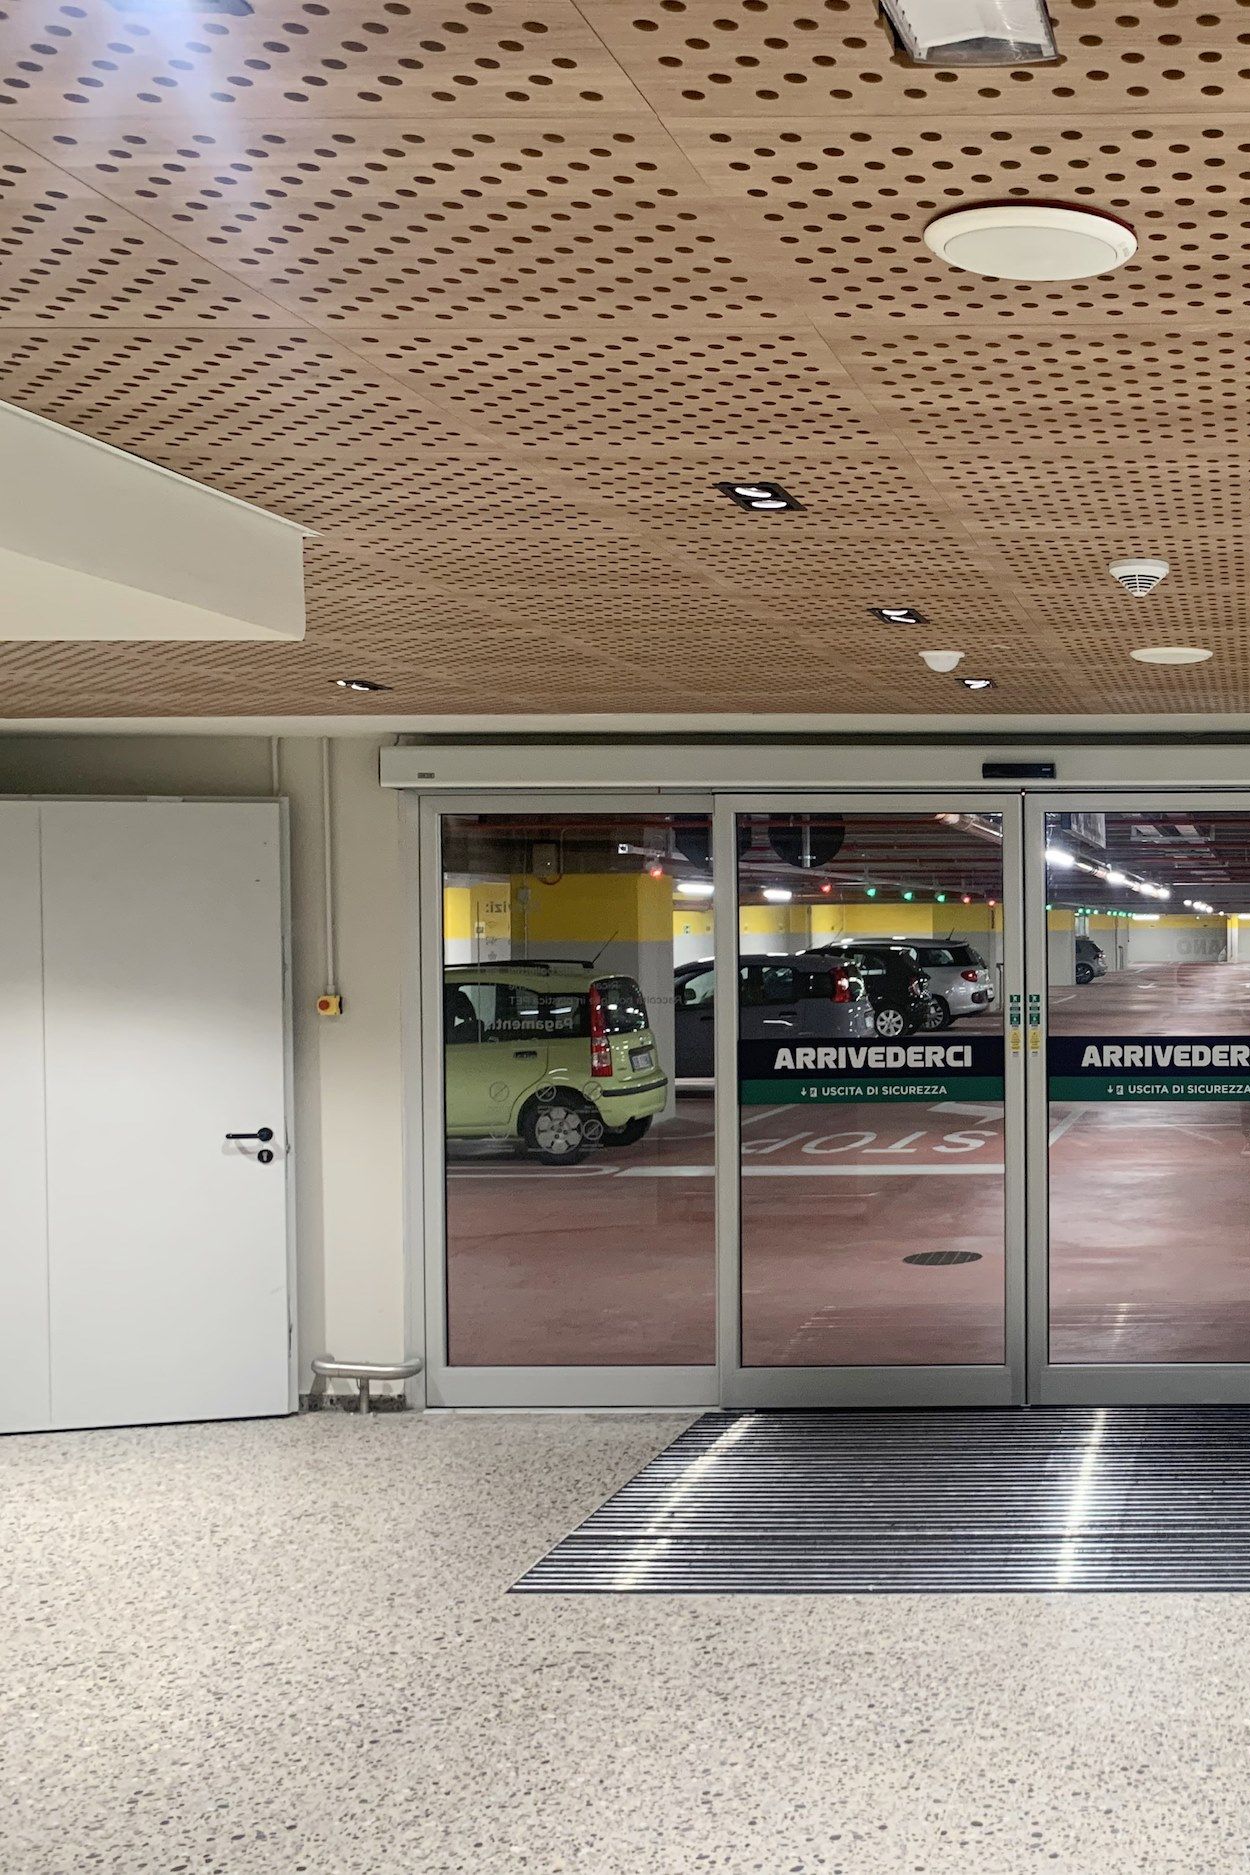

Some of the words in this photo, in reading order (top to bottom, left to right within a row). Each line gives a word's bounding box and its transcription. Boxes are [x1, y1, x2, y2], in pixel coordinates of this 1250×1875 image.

[774, 1045, 972, 1070] ARRIVEDERCI
[822, 1085, 863, 1096] USCITA
[866, 1085, 879, 1096] DI
[881, 1084, 947, 1096] SICUREZZA
[1128, 1084, 1169, 1095] USCITA
[1172, 1084, 1184, 1095] DI
[742, 1130, 998, 1155] STOP
